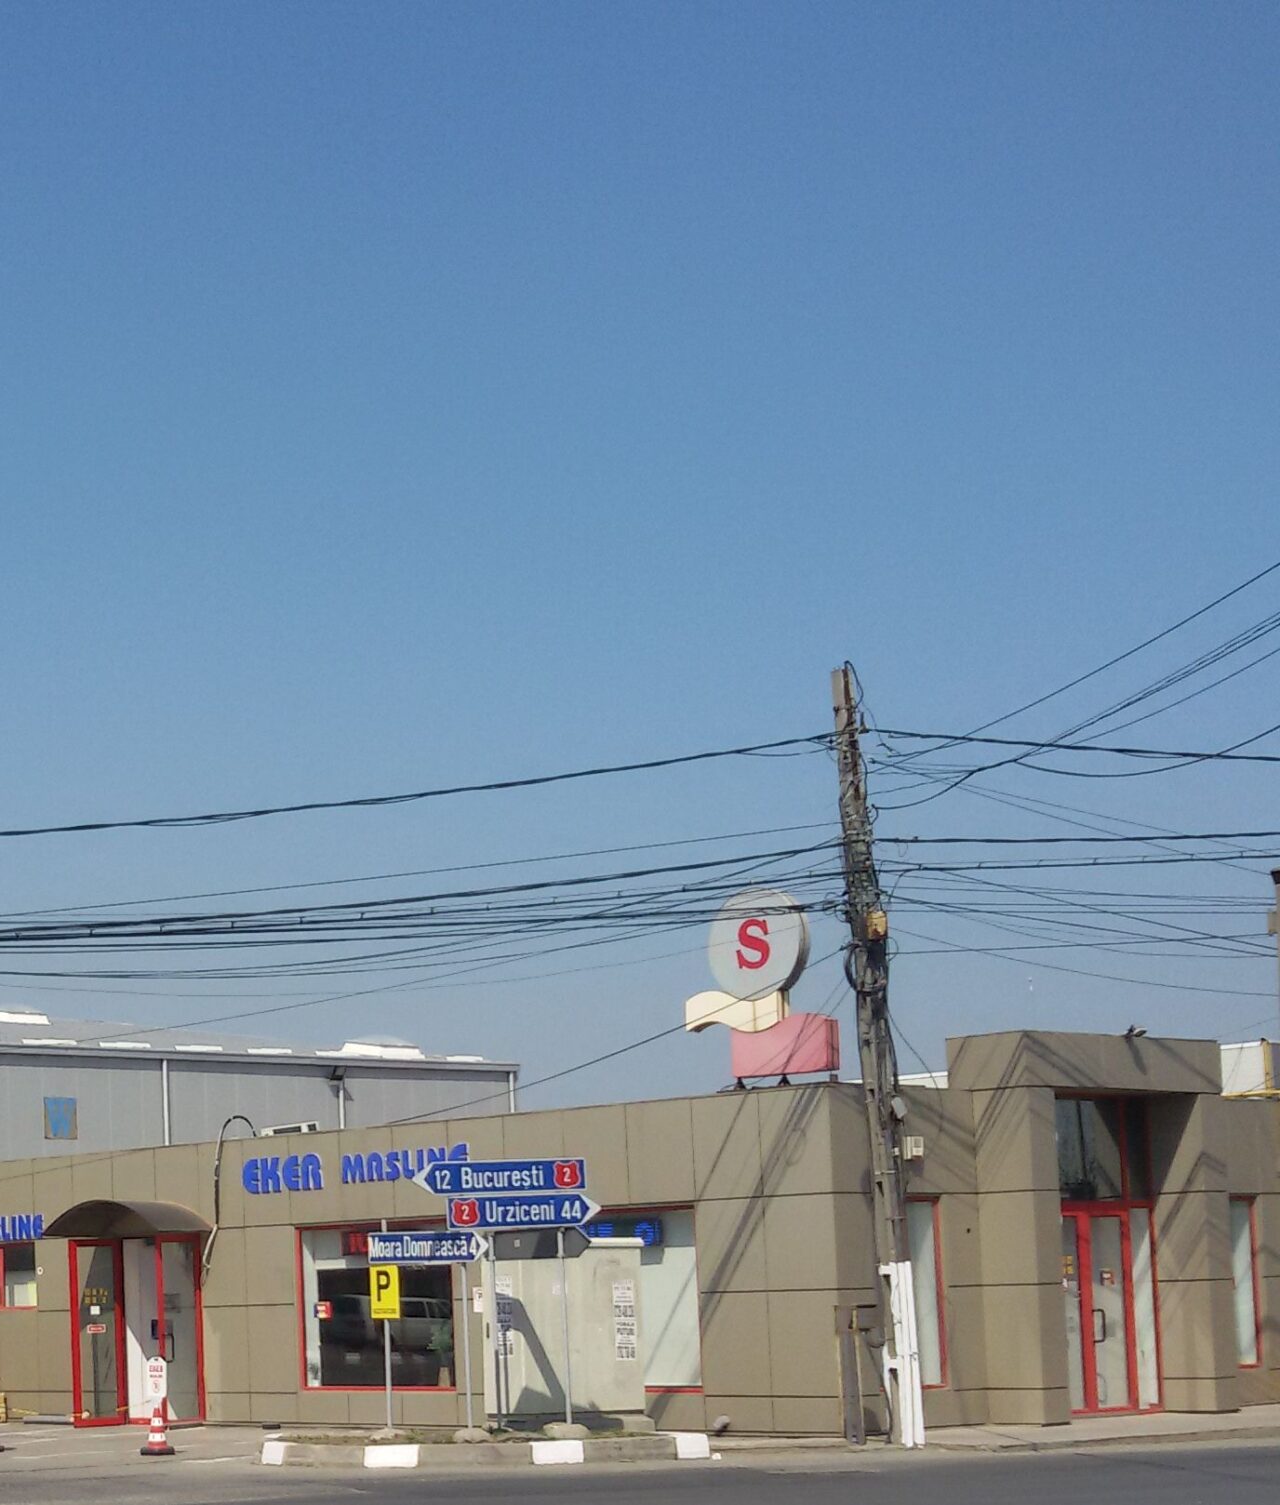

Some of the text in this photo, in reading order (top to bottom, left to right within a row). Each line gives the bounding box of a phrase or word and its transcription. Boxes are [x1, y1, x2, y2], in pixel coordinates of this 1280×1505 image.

[736, 918, 770, 969] S
[242, 1152, 323, 1194] EKER
[435, 1165, 571, 1190] 12 București 2
[462, 1200, 581, 1223] 2 Urziceni 44
[369, 1237, 402, 1258] Moara
[403, 1235, 467, 1257] Domnească
[469, 1236, 477, 1256] 4
